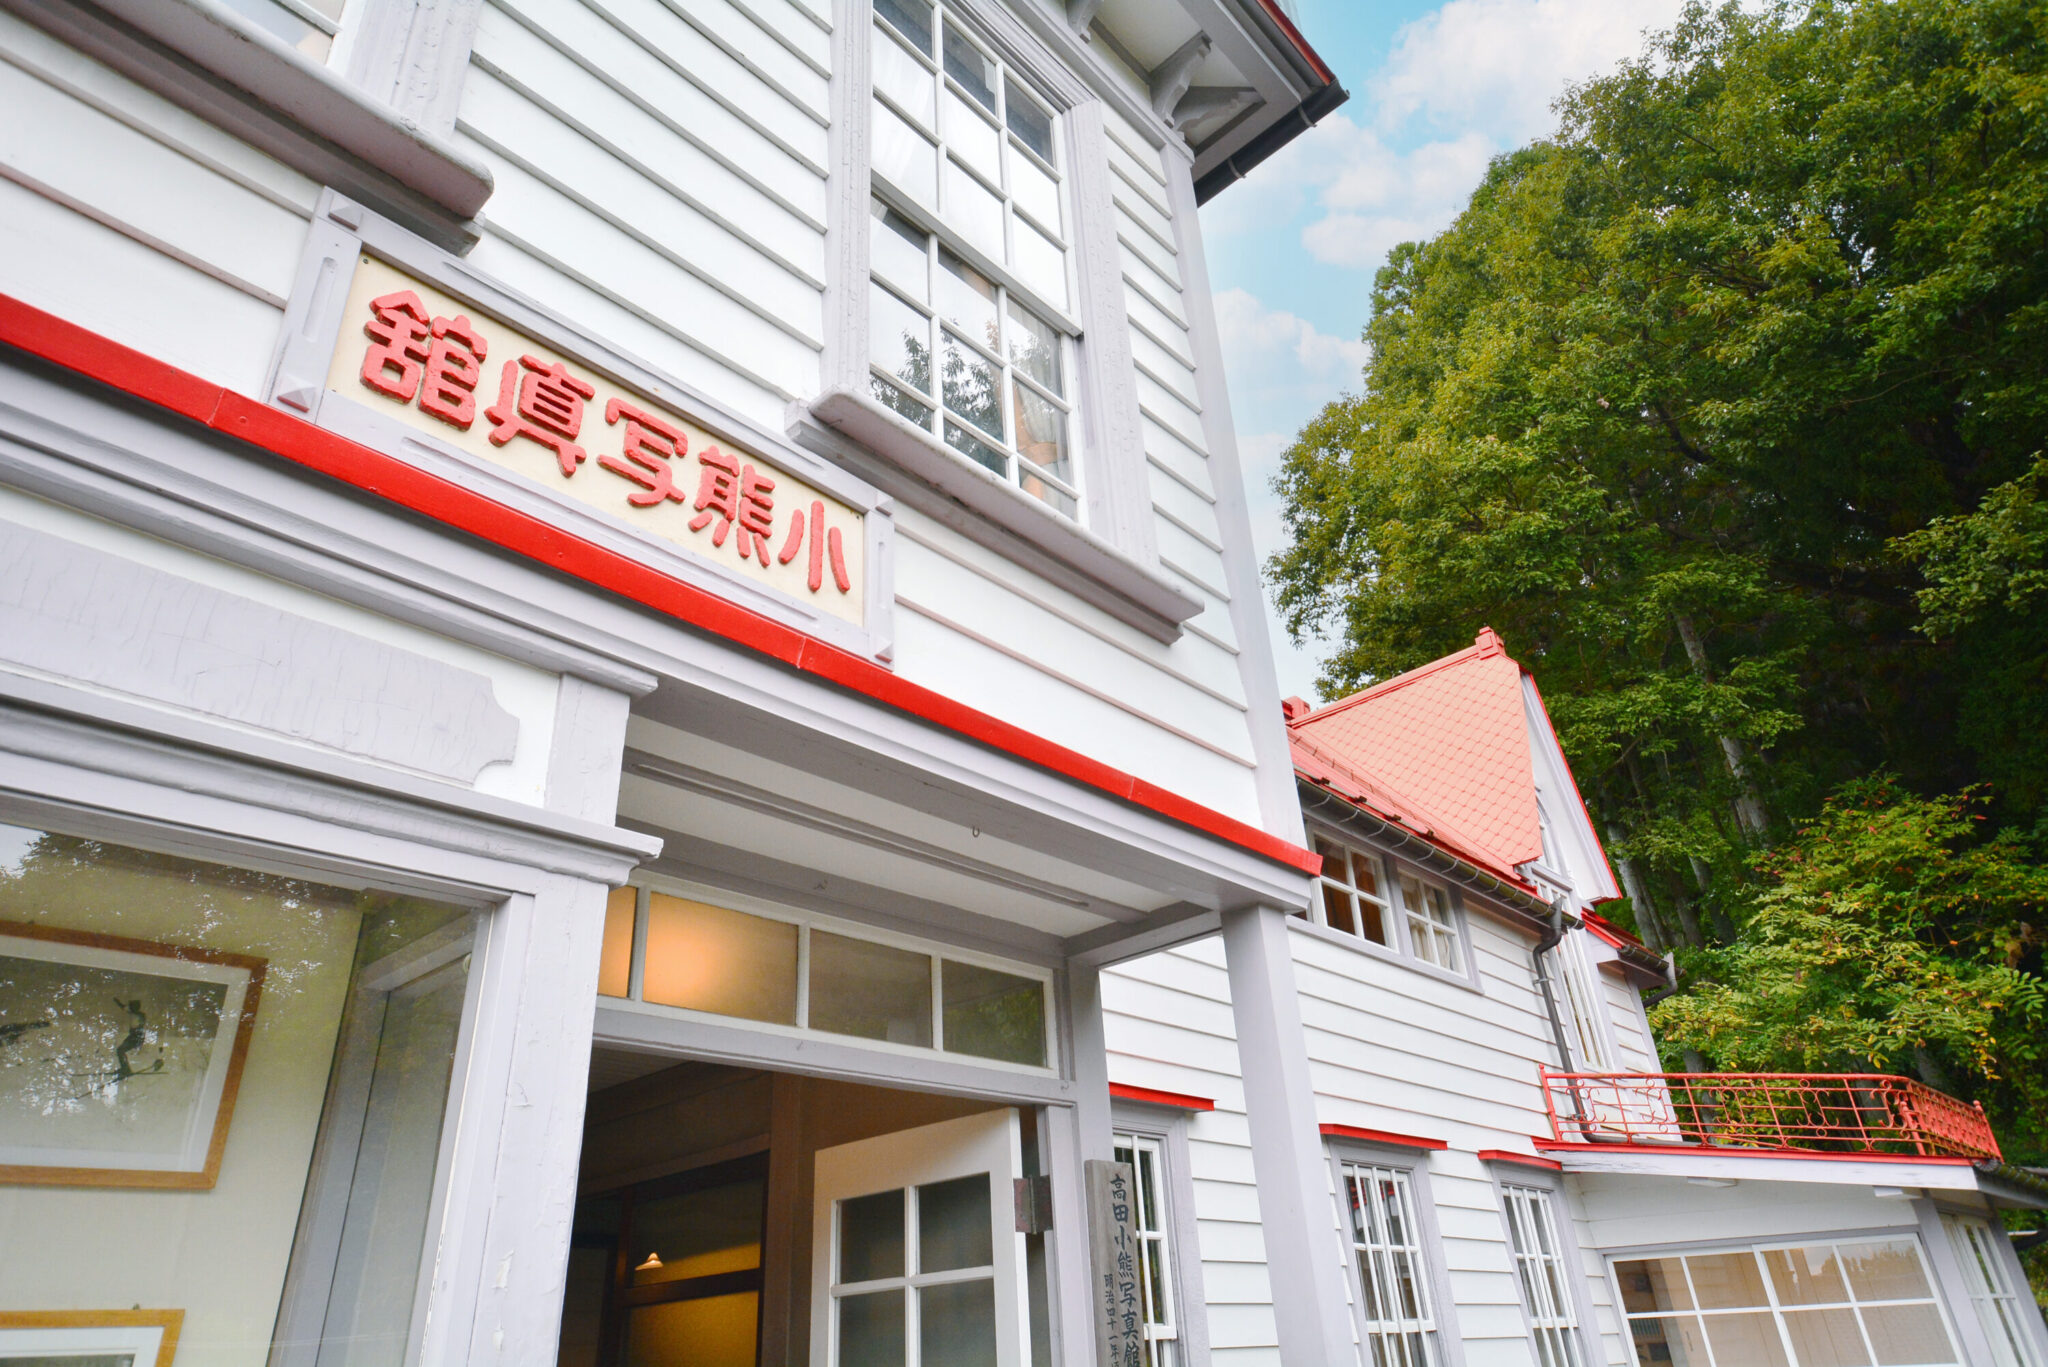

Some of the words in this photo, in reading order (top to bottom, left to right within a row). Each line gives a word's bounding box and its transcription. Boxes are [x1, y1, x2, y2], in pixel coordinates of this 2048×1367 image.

[1110, 1173, 1140, 1367] 高田小熊写真館
